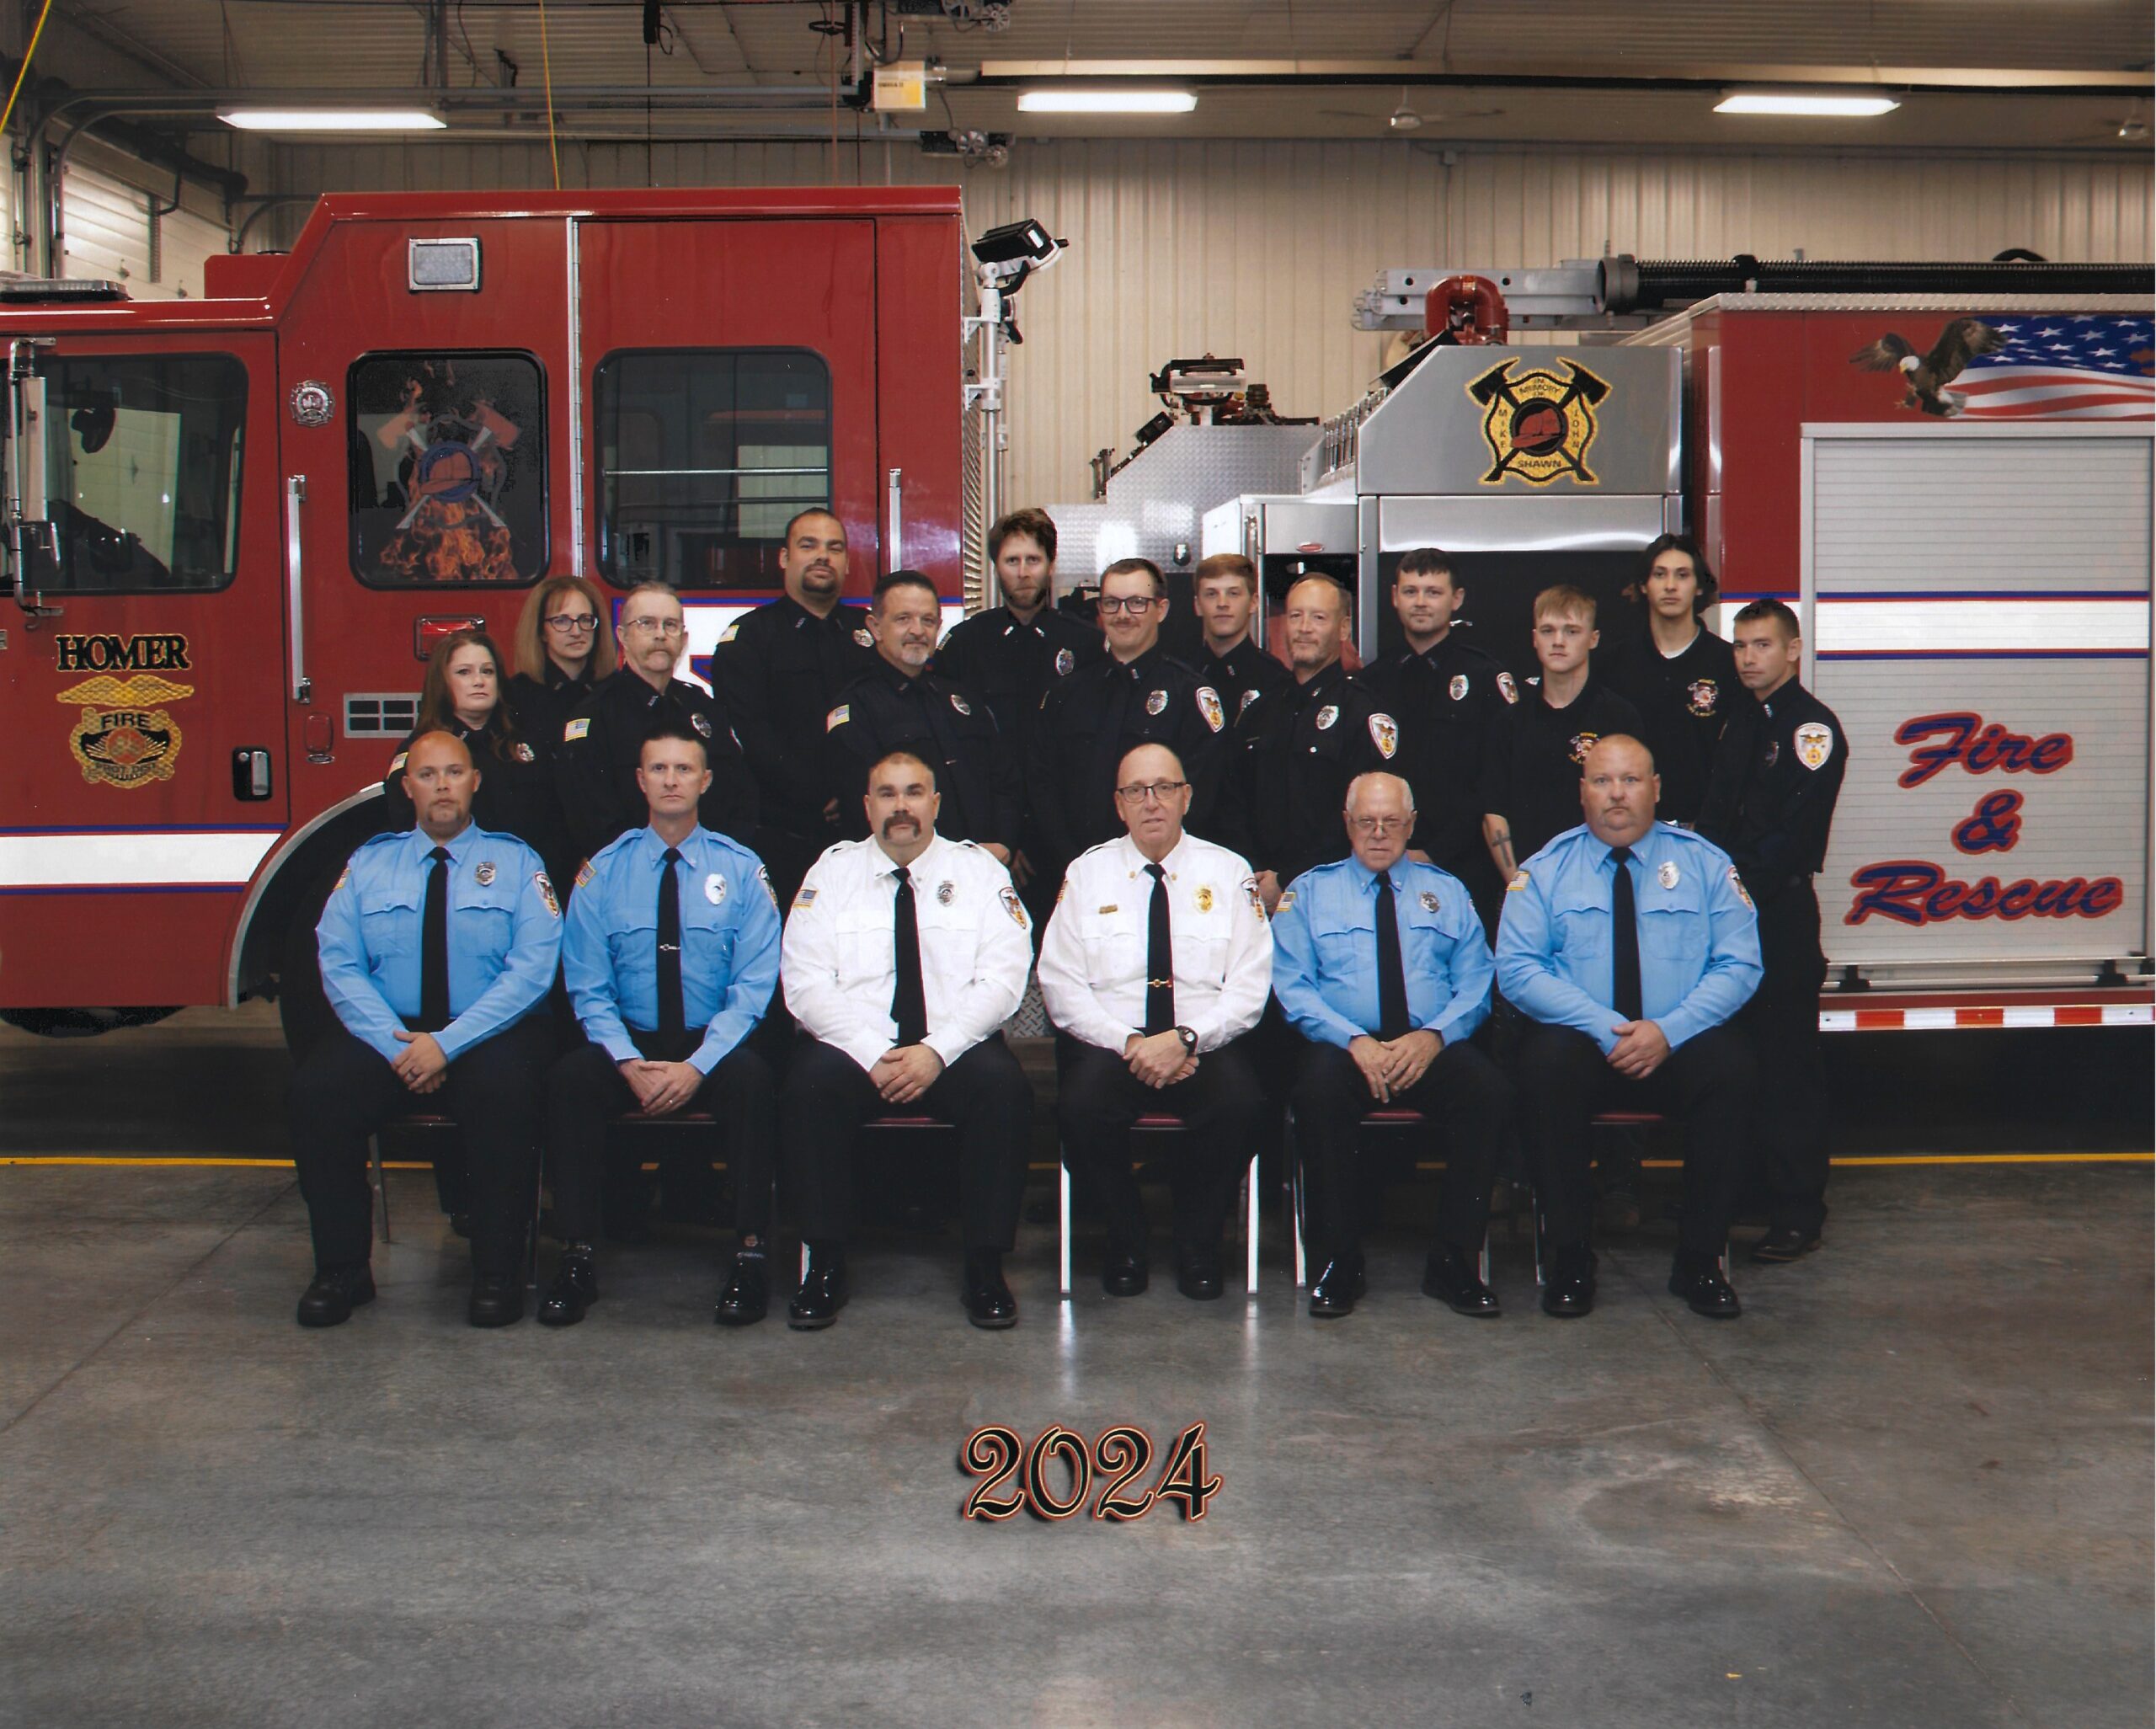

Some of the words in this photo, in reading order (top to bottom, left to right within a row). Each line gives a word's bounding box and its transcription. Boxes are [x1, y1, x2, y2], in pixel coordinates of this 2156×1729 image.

[1518, 459, 1562, 468] SHAWN
[56, 633, 192, 672] HOMER
[101, 712, 150, 728] FIRE
[1894, 712, 2073, 788] Fire
[1951, 789, 2024, 855] &
[1843, 859, 2123, 926] Rescue
